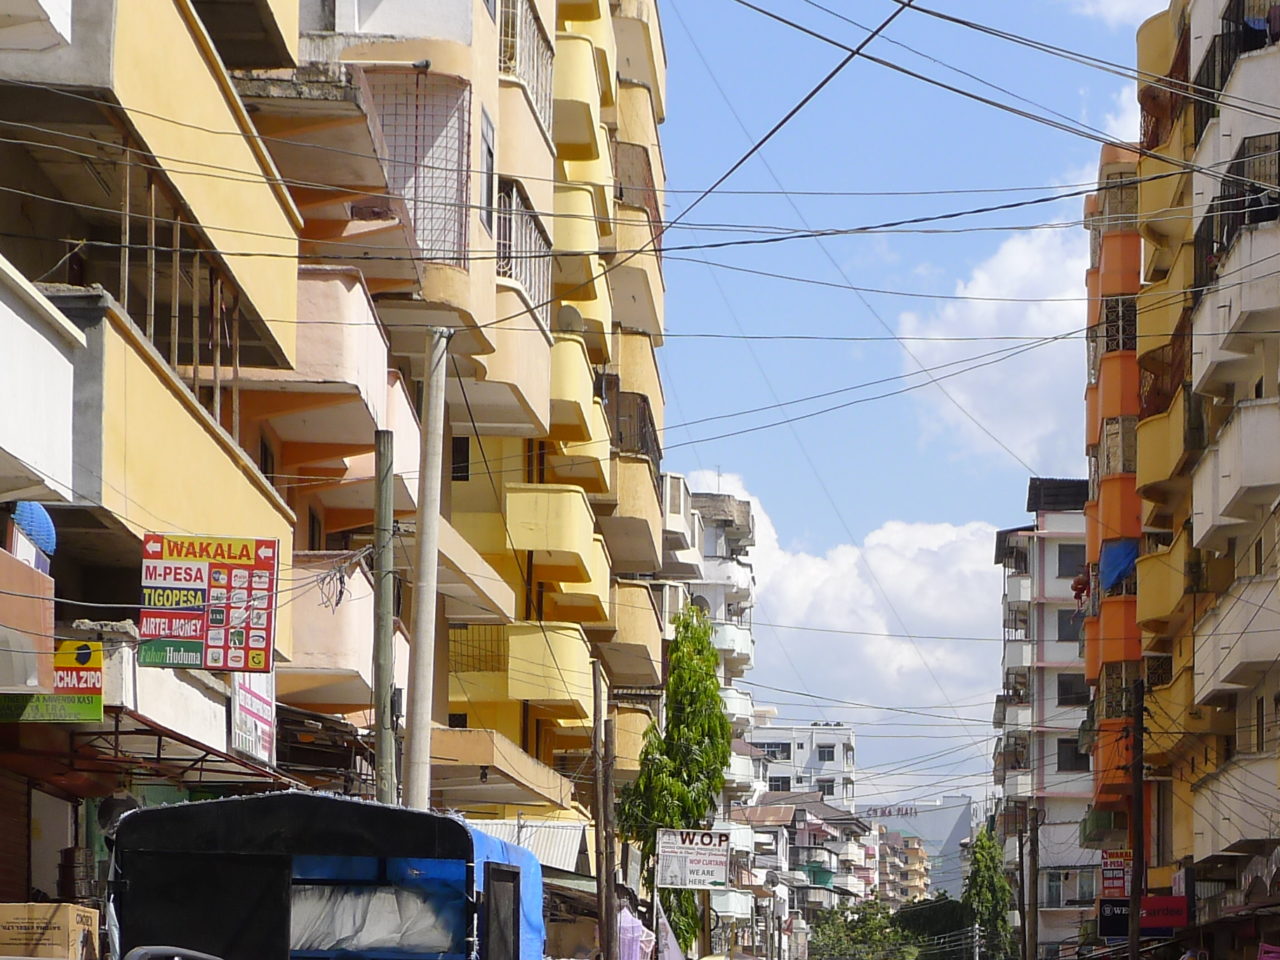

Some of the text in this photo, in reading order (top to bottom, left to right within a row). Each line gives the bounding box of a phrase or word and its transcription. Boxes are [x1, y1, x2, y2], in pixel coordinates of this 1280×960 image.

[166, 541, 252, 561] WAKALA
[144, 564, 204, 583] M-PESA
[143, 588, 203, 608] TIGOPESA
[141, 617, 202, 637] AIRTEL MONEY
[79, 671, 102, 688] ZIPO
[77, 696, 94, 704] KASI
[680, 831, 729, 847] W.O.P
